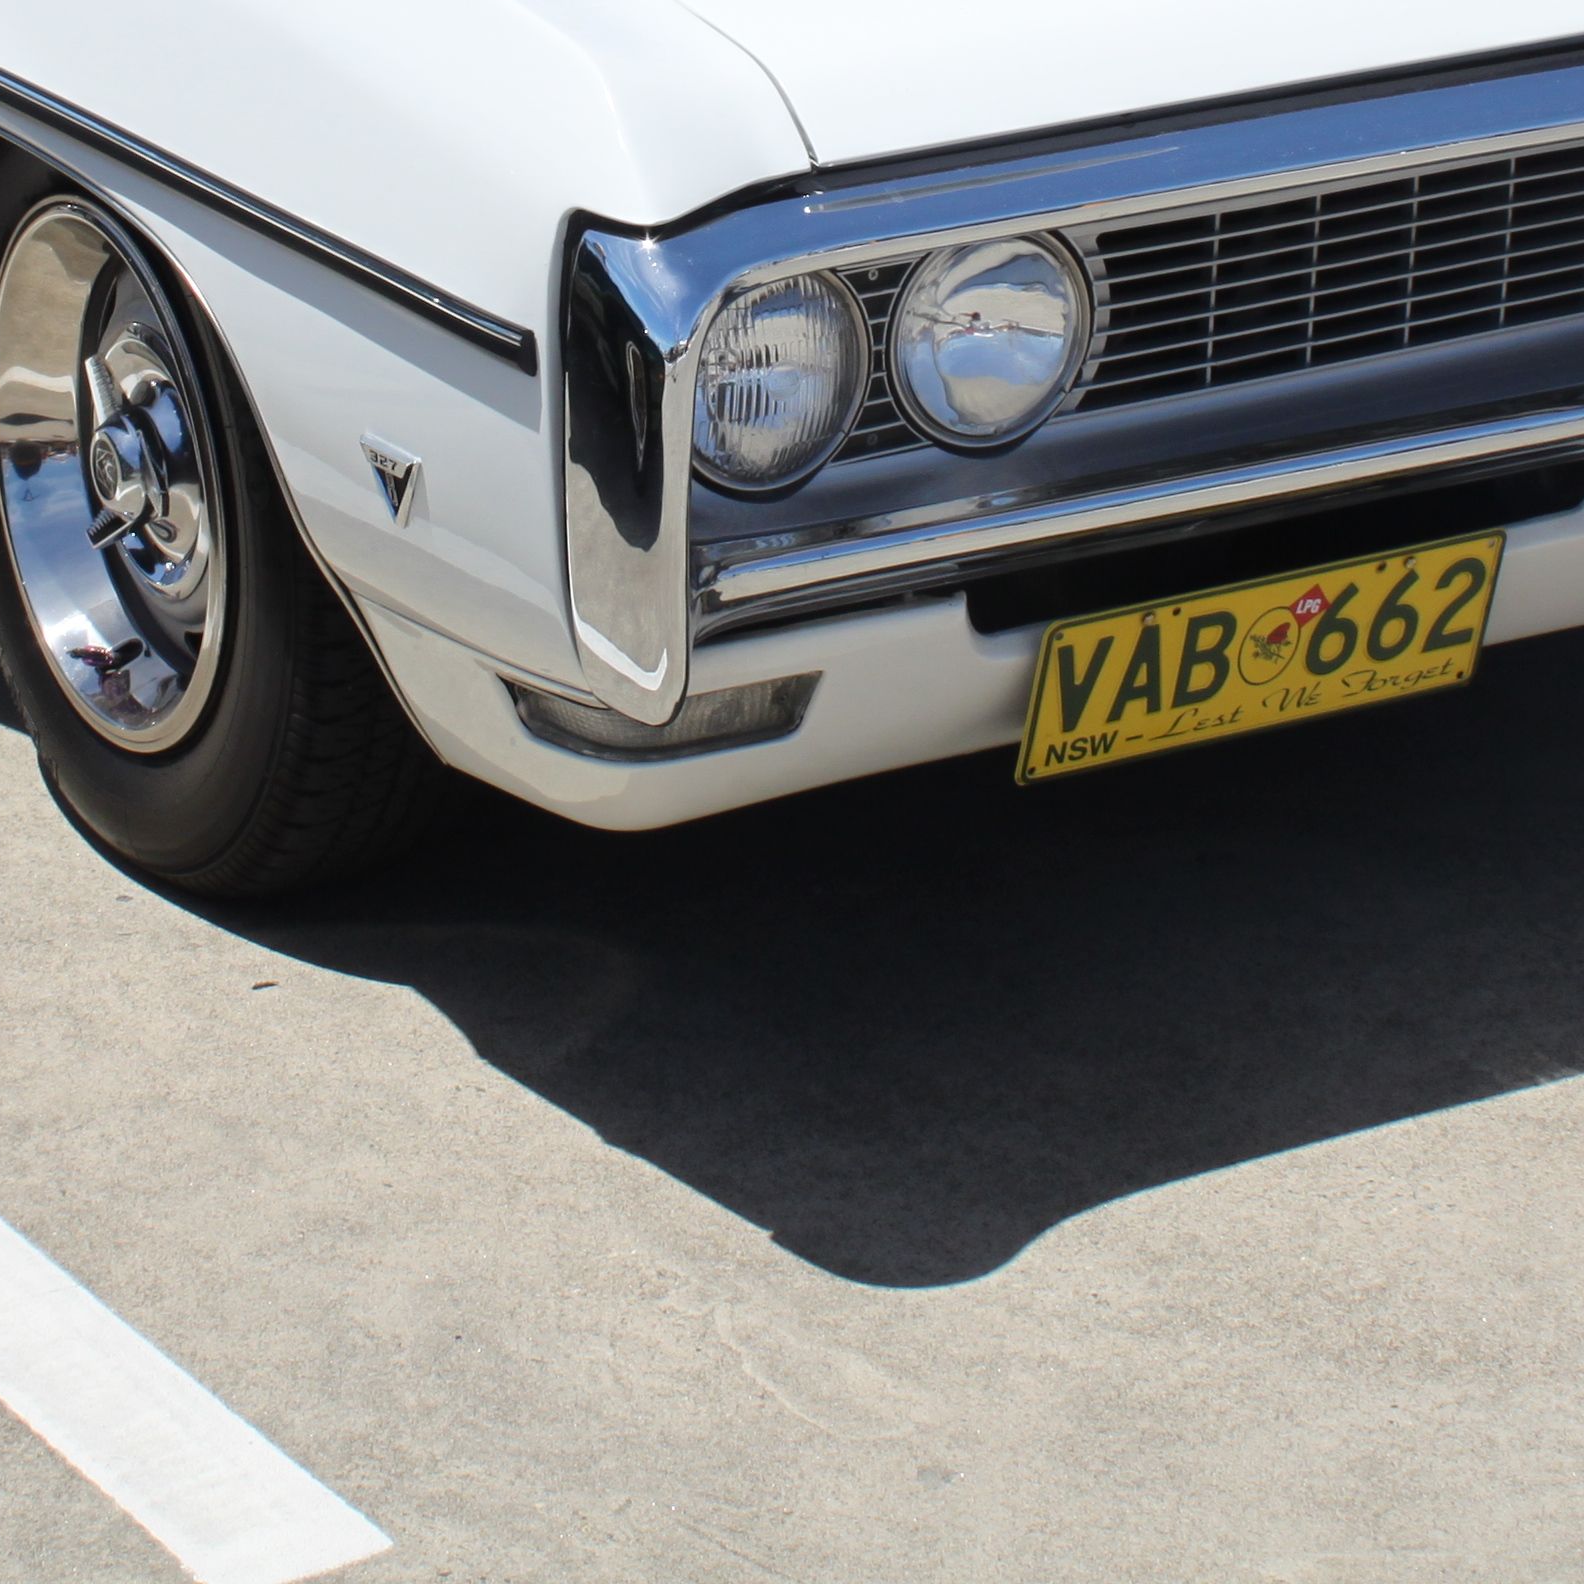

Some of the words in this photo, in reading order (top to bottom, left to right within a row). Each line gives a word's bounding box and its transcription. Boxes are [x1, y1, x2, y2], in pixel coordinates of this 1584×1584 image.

[368, 447, 398, 471] 327
[1296, 598, 1322, 615] LPG
[1056, 611, 1238, 733] VAB
[1305, 556, 1487, 676] 662
[1044, 729, 1119, 767] NSW
[1148, 705, 1245, 741] Lest
[1341, 657, 1455, 698] Forget
